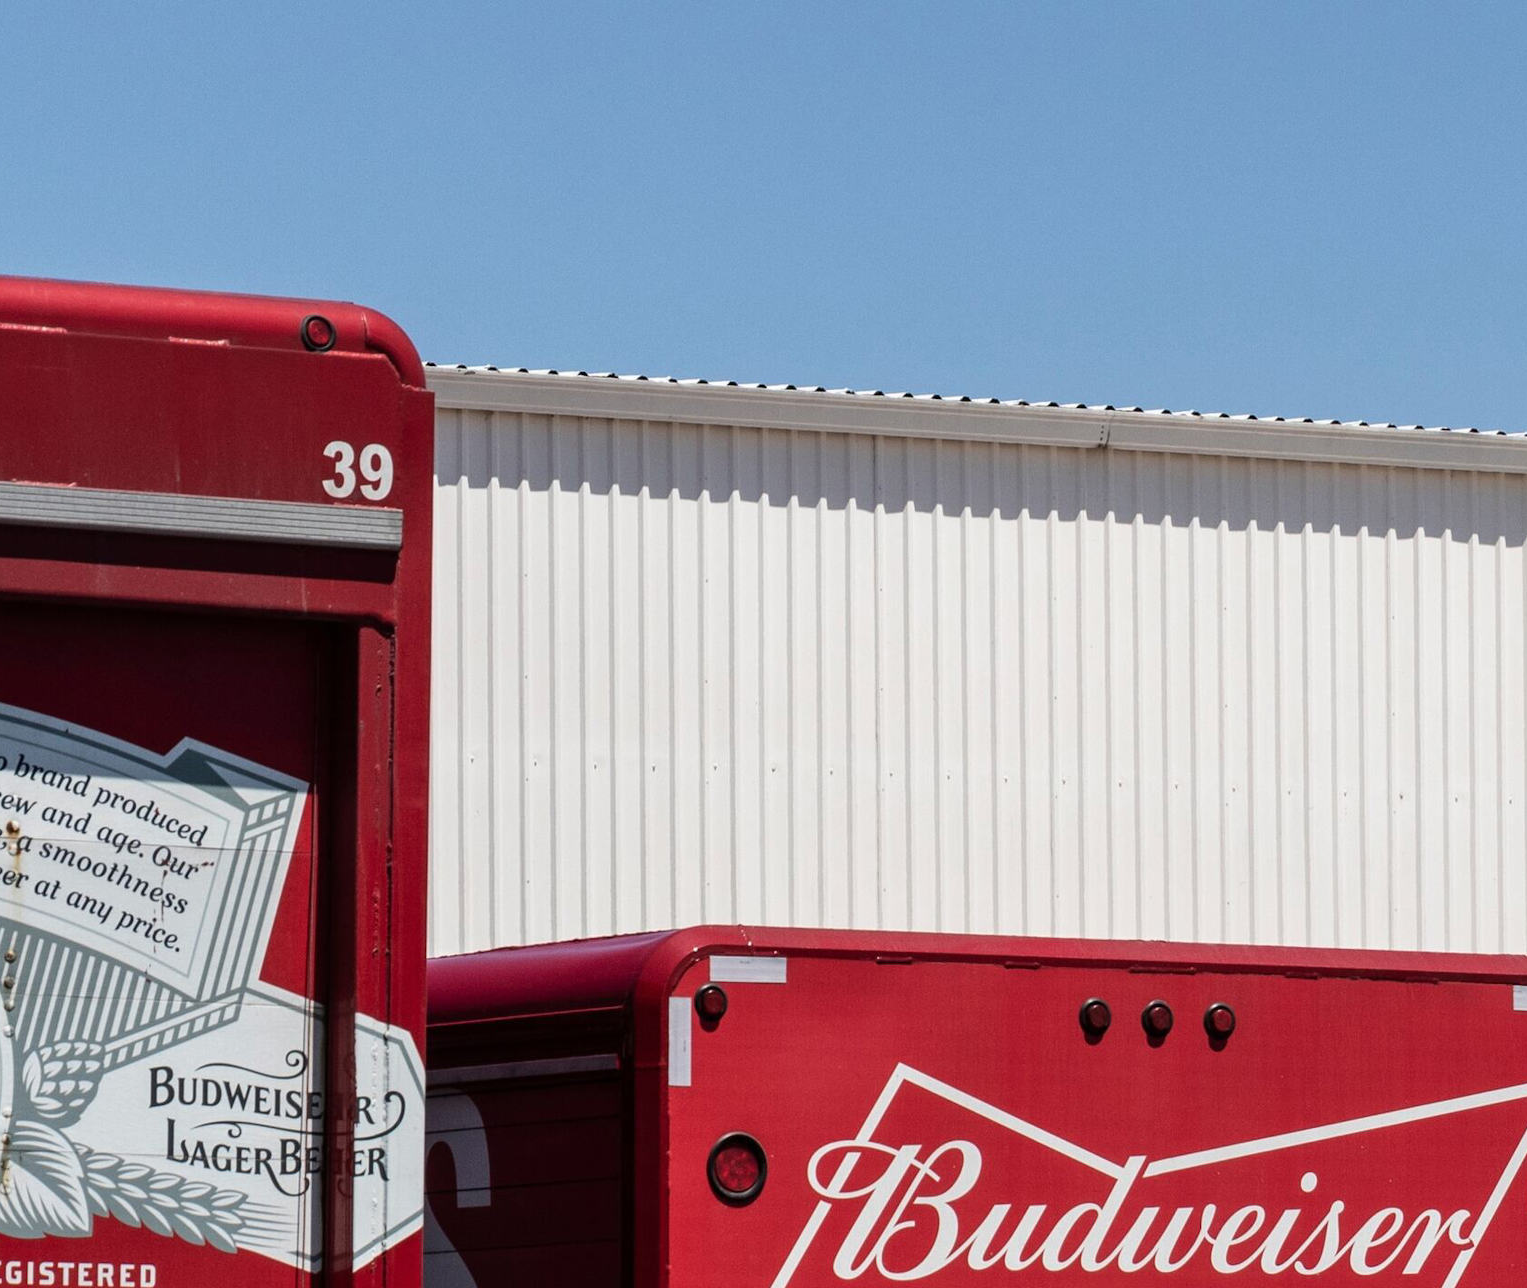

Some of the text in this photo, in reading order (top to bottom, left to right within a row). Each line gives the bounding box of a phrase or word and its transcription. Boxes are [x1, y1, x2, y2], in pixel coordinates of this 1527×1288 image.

[322, 440, 394, 501] 39
[14, 753, 91, 797] brand
[92, 787, 208, 847] produced
[16, 837, 34, 854] a
[39, 843, 188, 915] smoothness
[41, 807, 92, 834] and
[97, 827, 143, 858] age.
[152, 845, 201, 879] Our
[34, 880, 61, 900] at
[66, 891, 113, 924] any
[115, 911, 180, 952] price.
[807, 1139, 1474, 1281] Budweiser
